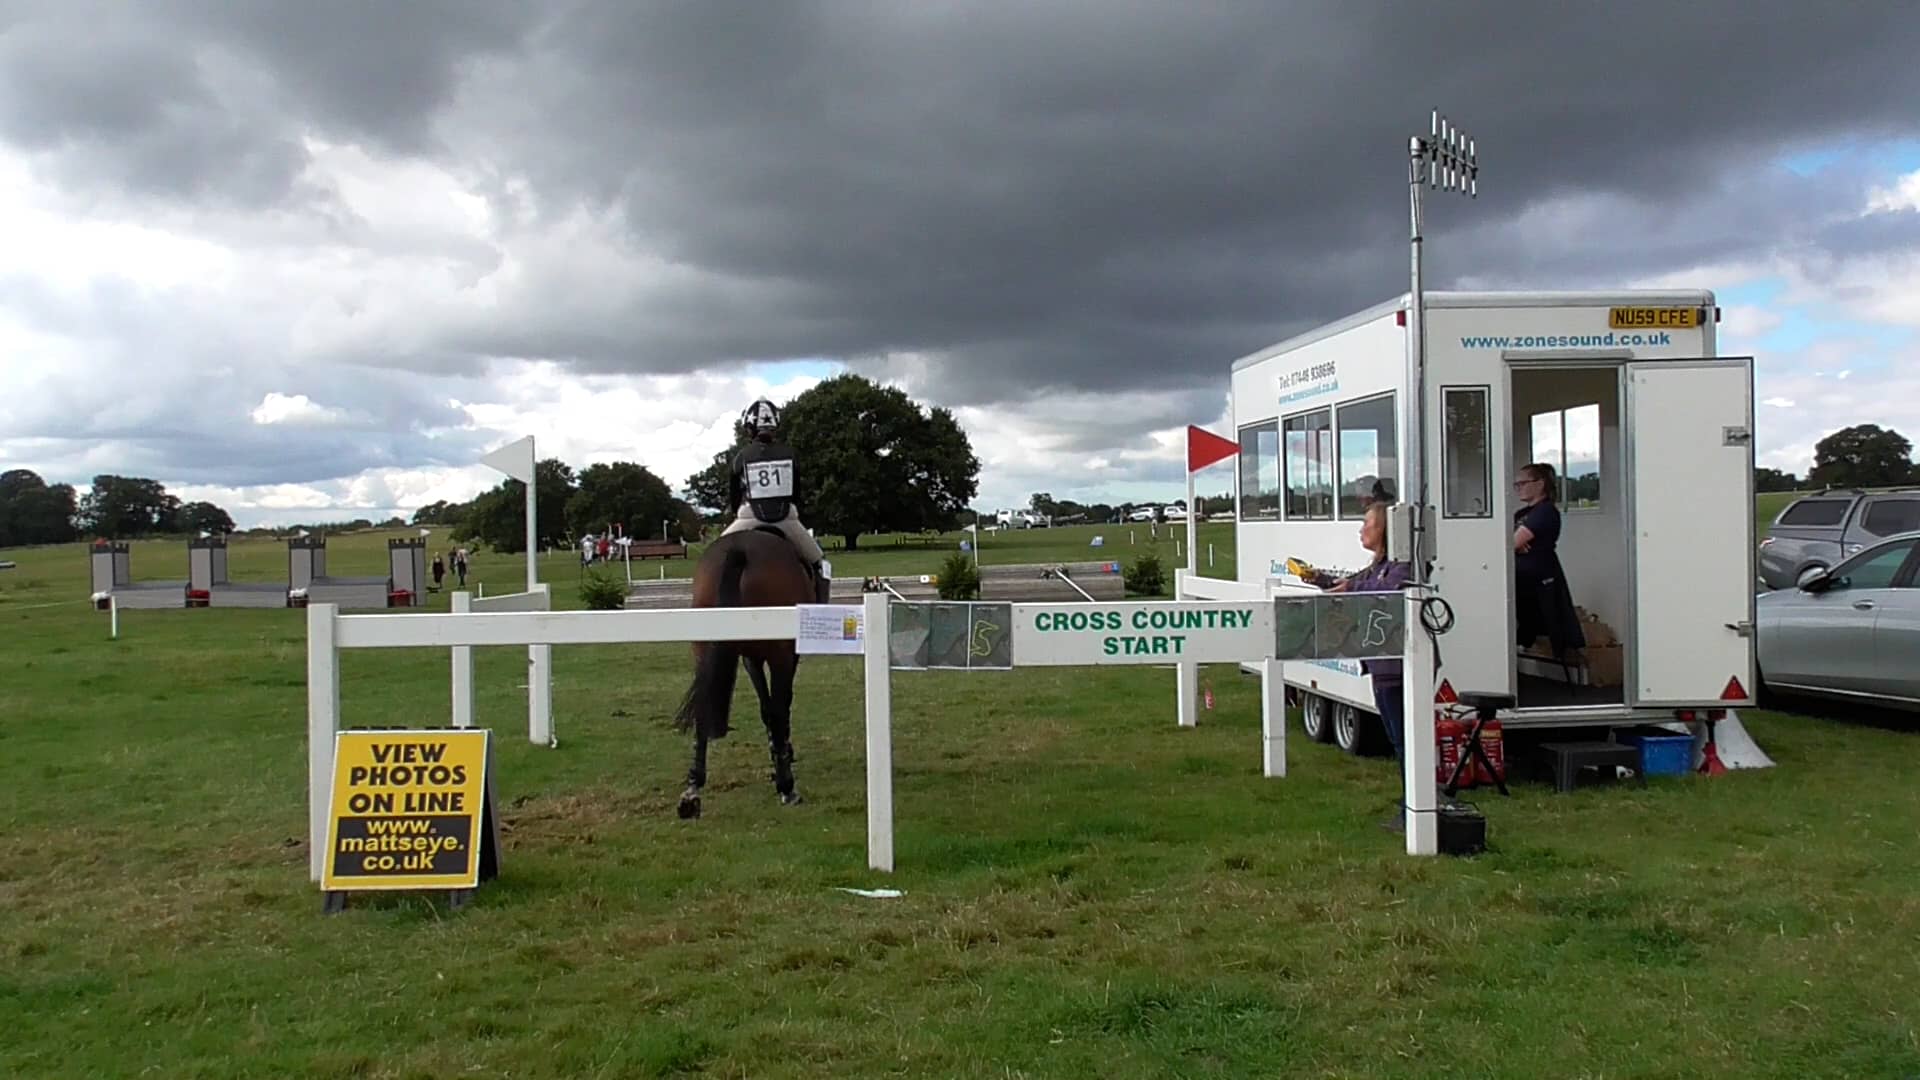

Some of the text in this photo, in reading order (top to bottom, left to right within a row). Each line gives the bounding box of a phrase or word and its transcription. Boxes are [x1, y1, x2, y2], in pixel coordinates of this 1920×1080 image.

[1615, 309, 1688, 325] NU59 CFE
[1461, 331, 1670, 348] www.zonesound.co.uk
[758, 468, 781, 487] 81
[1035, 610, 1253, 631] CROSS COUNTRY
[1103, 635, 1186, 655] START
[371, 743, 447, 763] VIEW
[349, 765, 467, 786] PHOTOS
[348, 792, 465, 813] ON LINE
[366, 820, 437, 834] www.
[340, 835, 465, 853] mattseye.
[362, 852, 435, 871] co.uk
